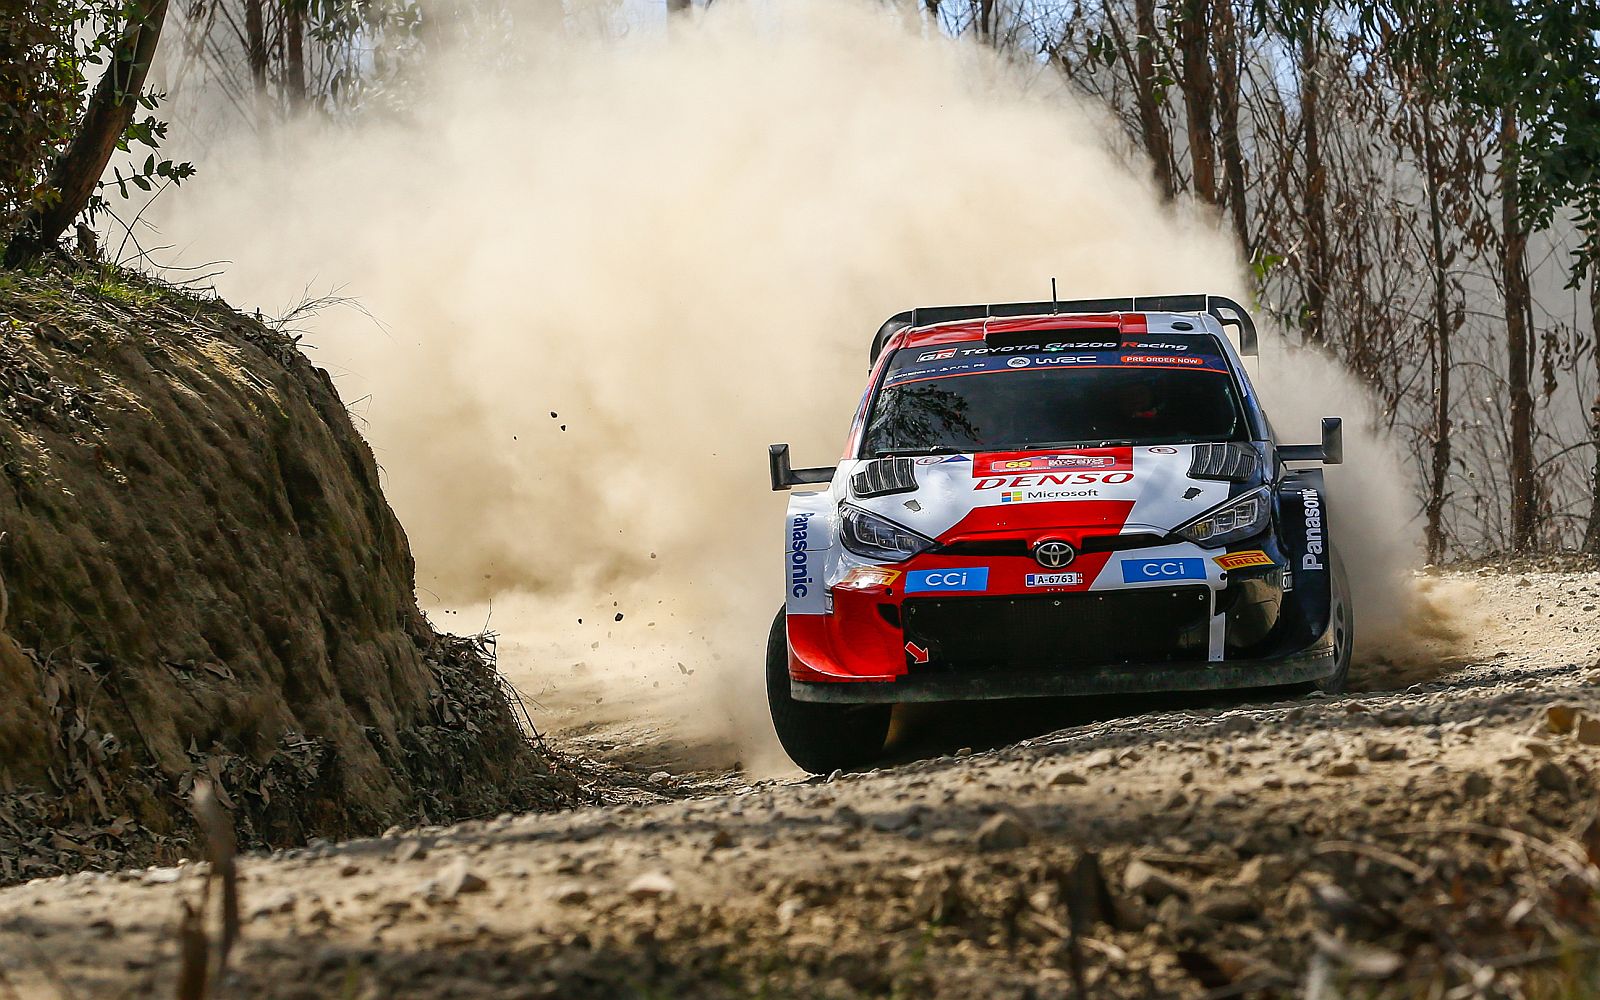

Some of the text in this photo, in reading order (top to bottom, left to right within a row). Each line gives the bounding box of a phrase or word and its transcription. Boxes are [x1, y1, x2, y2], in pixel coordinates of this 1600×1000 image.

[960, 341, 1188, 356] TOYOTA GAZOO Racing
[920, 350, 955, 362] GR
[1035, 355, 1097, 365] WRC
[1005, 461, 1032, 469] 69
[973, 473, 1135, 491] DENSO
[1027, 489, 1099, 499] Microsoft
[1296, 487, 1323, 571] Panasonic
[791, 512, 816, 599] Panasonic
[1218, 552, 1269, 568] PIRELLI
[1037, 574, 1073, 584] A-6763
